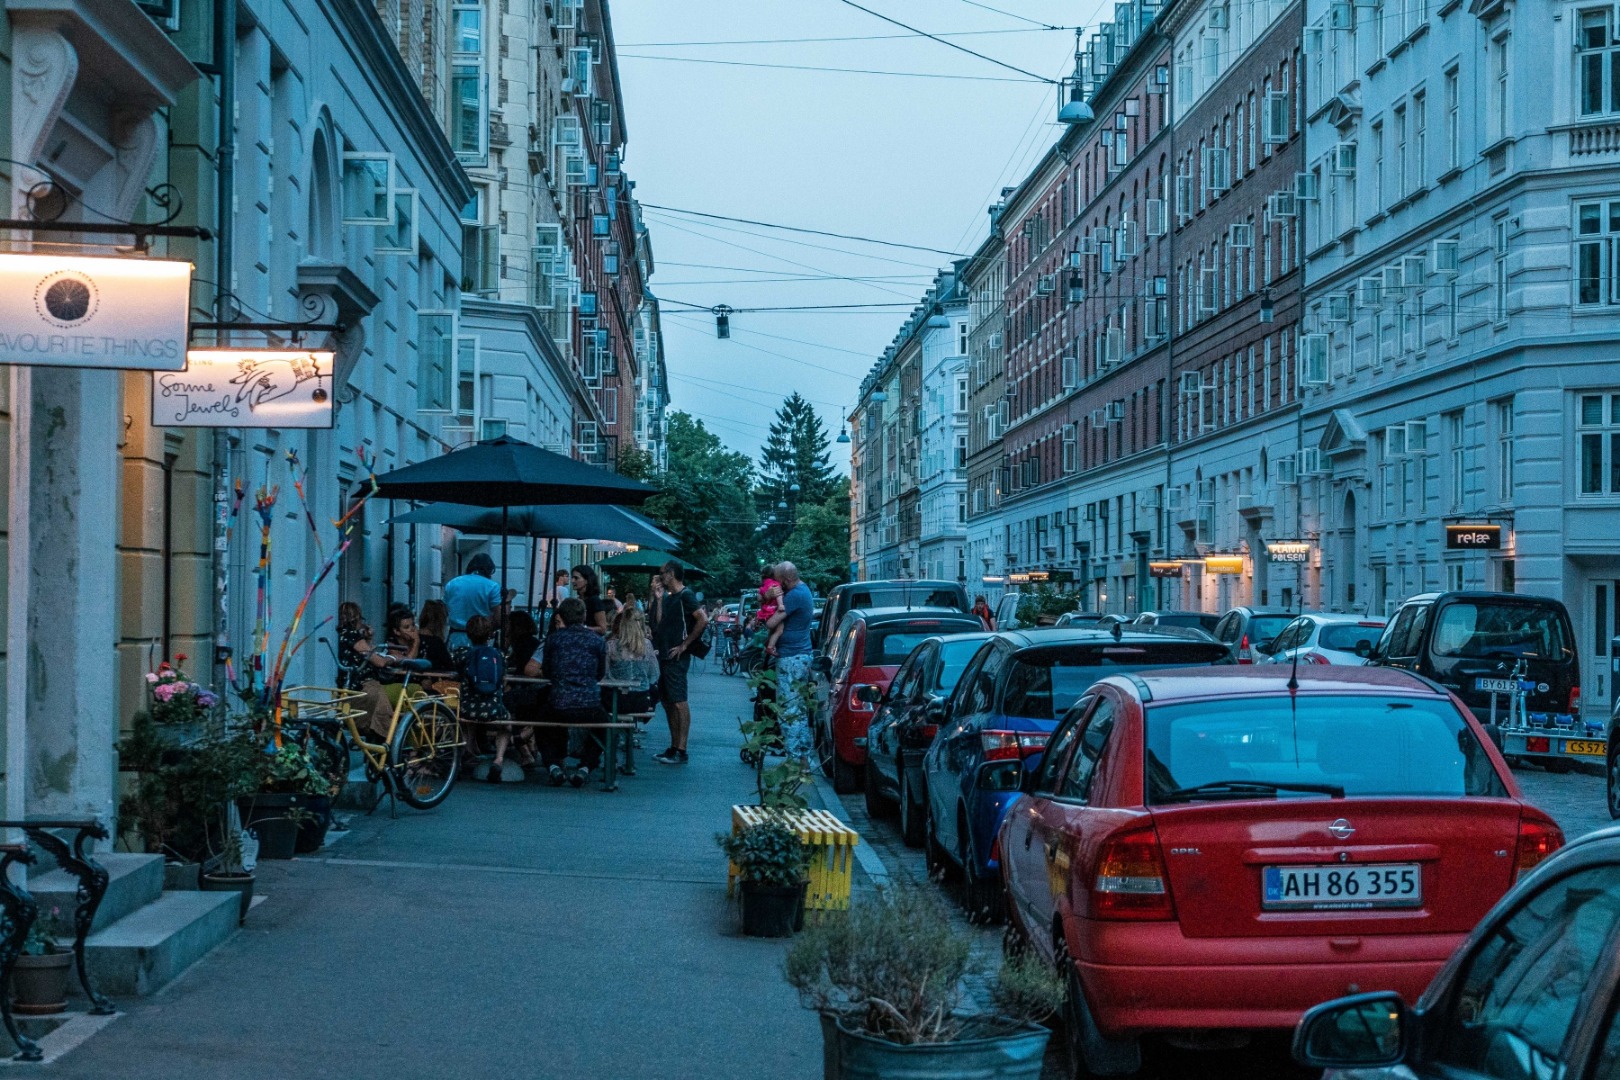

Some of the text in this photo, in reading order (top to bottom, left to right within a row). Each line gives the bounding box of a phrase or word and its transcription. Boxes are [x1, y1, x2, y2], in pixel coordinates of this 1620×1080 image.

[100, 336, 178, 358] THINGS
[174, 394, 239, 422] Jewels
[1457, 532, 1490, 544] relæ
[1272, 545, 1305, 553] PLANTE
[1272, 553, 1306, 562] PØLSEN
[1482, 679, 1494, 689] BY
[1497, 680, 1507, 690] 61
[1570, 742, 1585, 752] CS
[1587, 743, 1600, 753] 57
[1284, 870, 1415, 896] AH 86 355
[1268, 887, 1279, 895] DK
